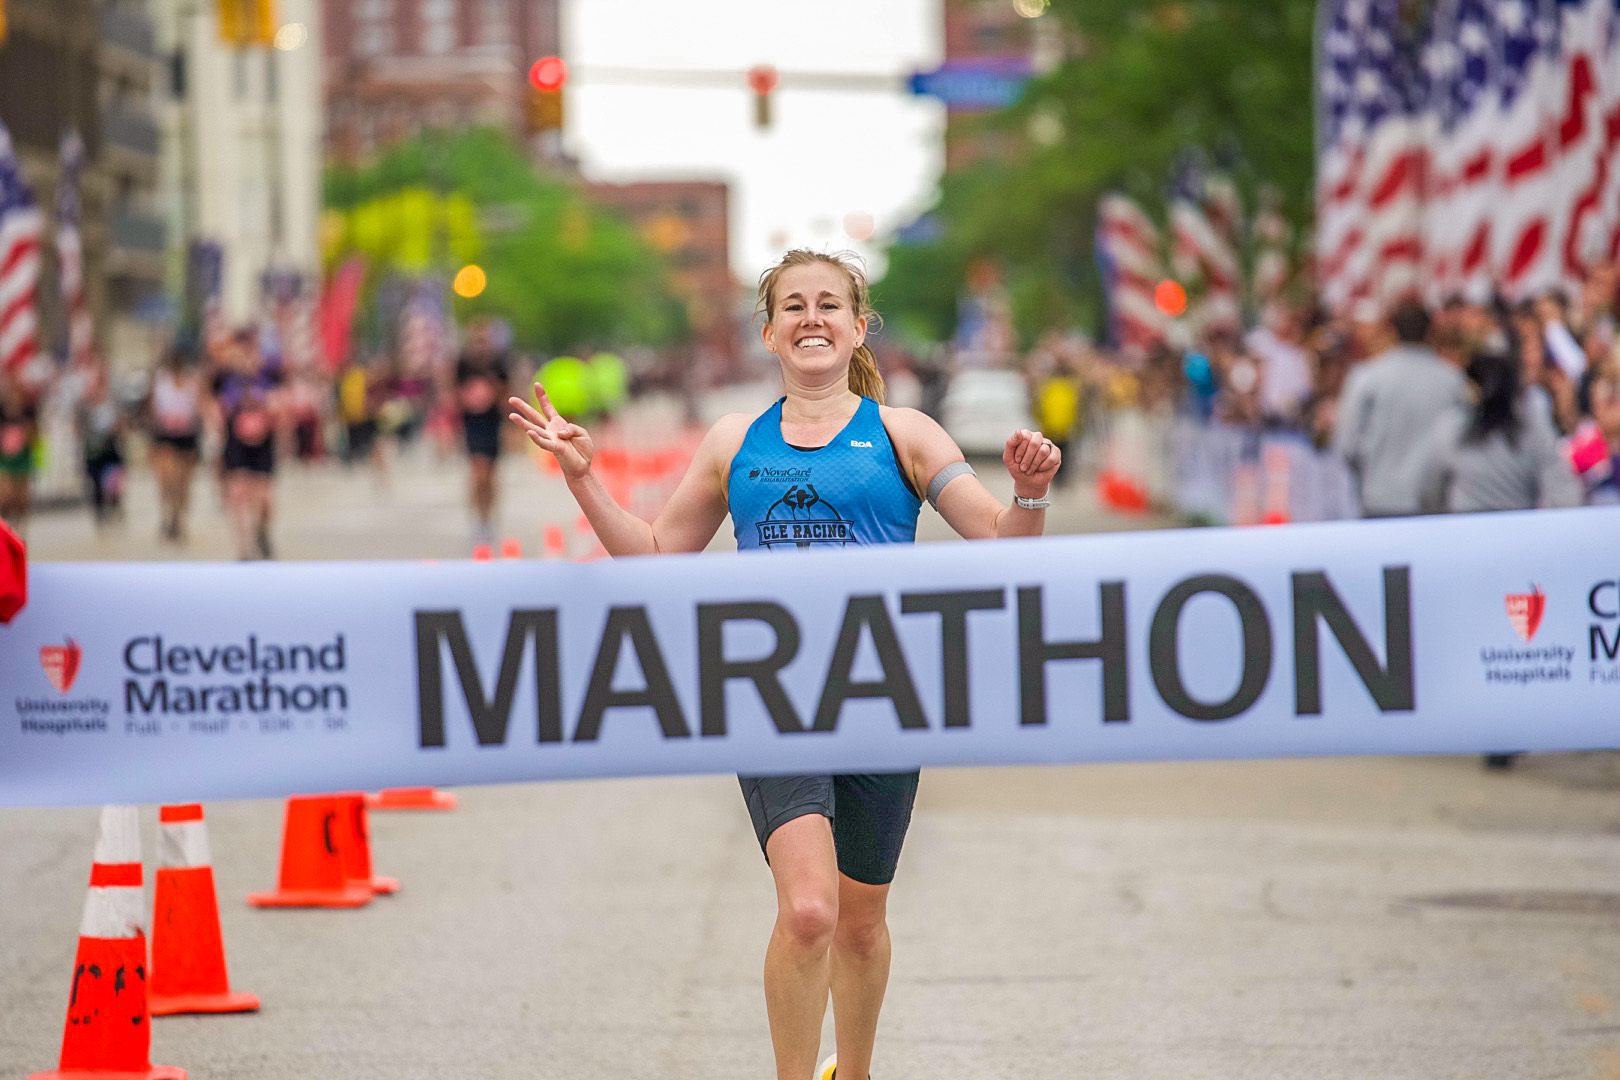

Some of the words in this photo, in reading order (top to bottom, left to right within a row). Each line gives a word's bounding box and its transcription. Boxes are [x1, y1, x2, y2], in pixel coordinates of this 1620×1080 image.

[763, 525, 788, 539] CLE
[793, 524, 846, 538] RACING
[124, 635, 346, 675] Cleveland
[415, 565, 1416, 747] MARATHON
[1480, 645, 1575, 662] University
[1485, 666, 1571, 684] Hospitals
[125, 677, 348, 714] Marathon
[16, 696, 109, 714] University
[21, 716, 108, 734] Hospitals
